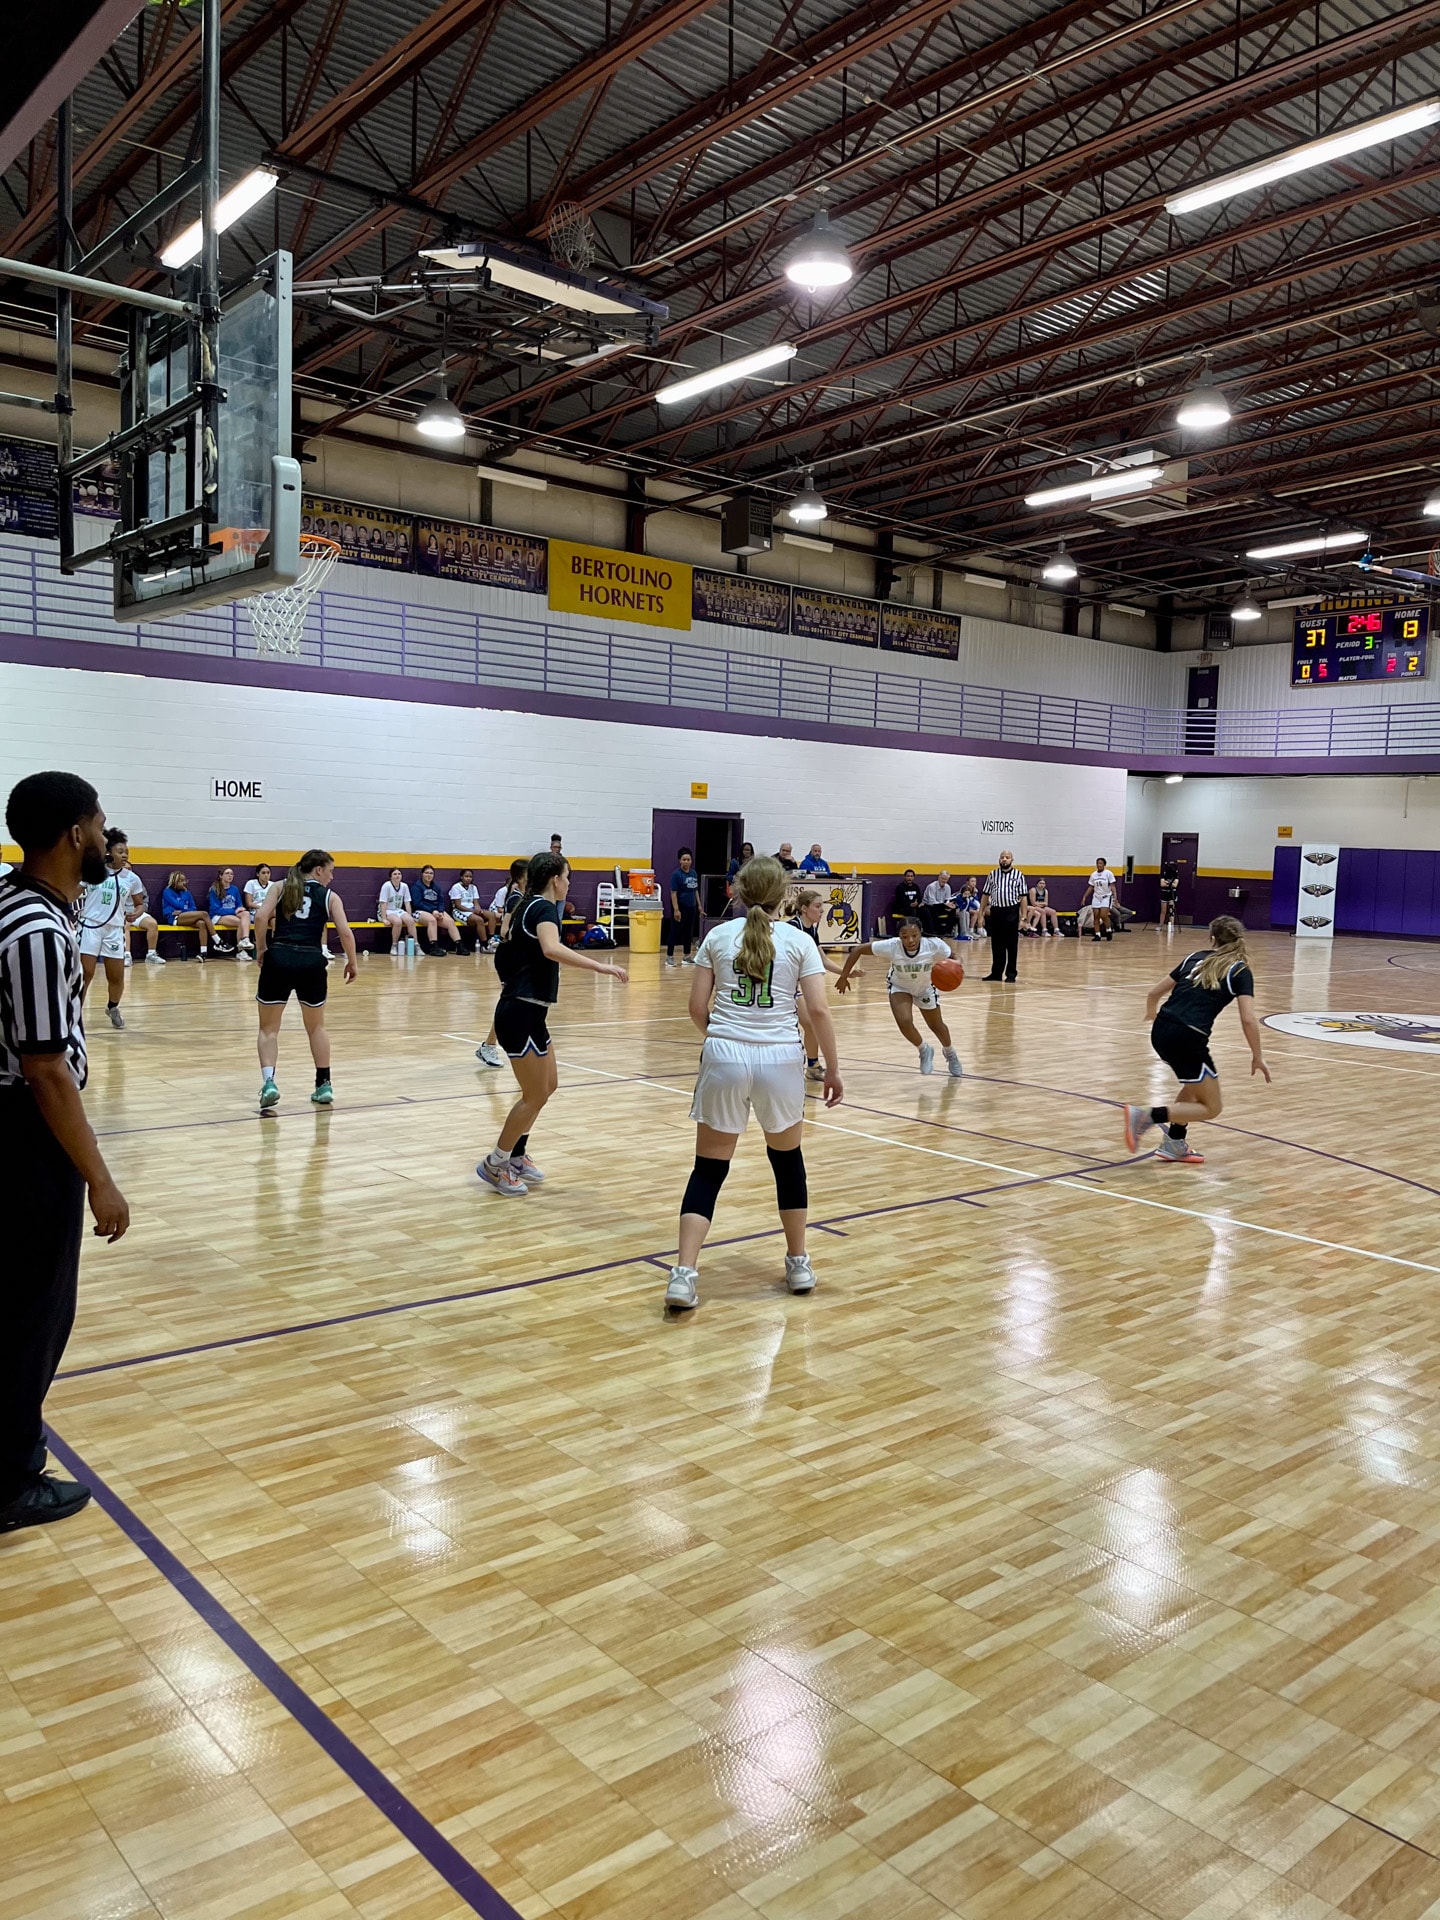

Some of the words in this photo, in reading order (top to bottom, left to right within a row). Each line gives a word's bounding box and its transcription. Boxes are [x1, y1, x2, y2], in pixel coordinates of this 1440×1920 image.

[340, 549, 358, 558] CITY
[360, 552, 403, 564] CHAMPIONS
[472, 571, 487, 580] CITY
[490, 574, 527, 586] CHAMPIONS
[571, 556, 672, 591] BERTOLINO
[579, 583, 665, 614] HORNETS
[1395, 609, 1422, 618] HOME
[1300, 619, 1328, 628] GUEST
[1347, 613, 1381, 633] 2:46
[1305, 628, 1326, 647] 37
[1336, 640, 1360, 649] PERIOD
[1364, 636, 1373, 650] 3
[1318, 663, 1328, 678] 5
[1386, 658, 1396, 673] 2
[1408, 657, 1418, 671] 2
[1301, 665, 1310, 679] 0
[215, 780, 262, 798] HOME
[981, 820, 1014, 833] VISITORS
[295, 896, 312, 919] 3
[731, 957, 774, 1008] 31
